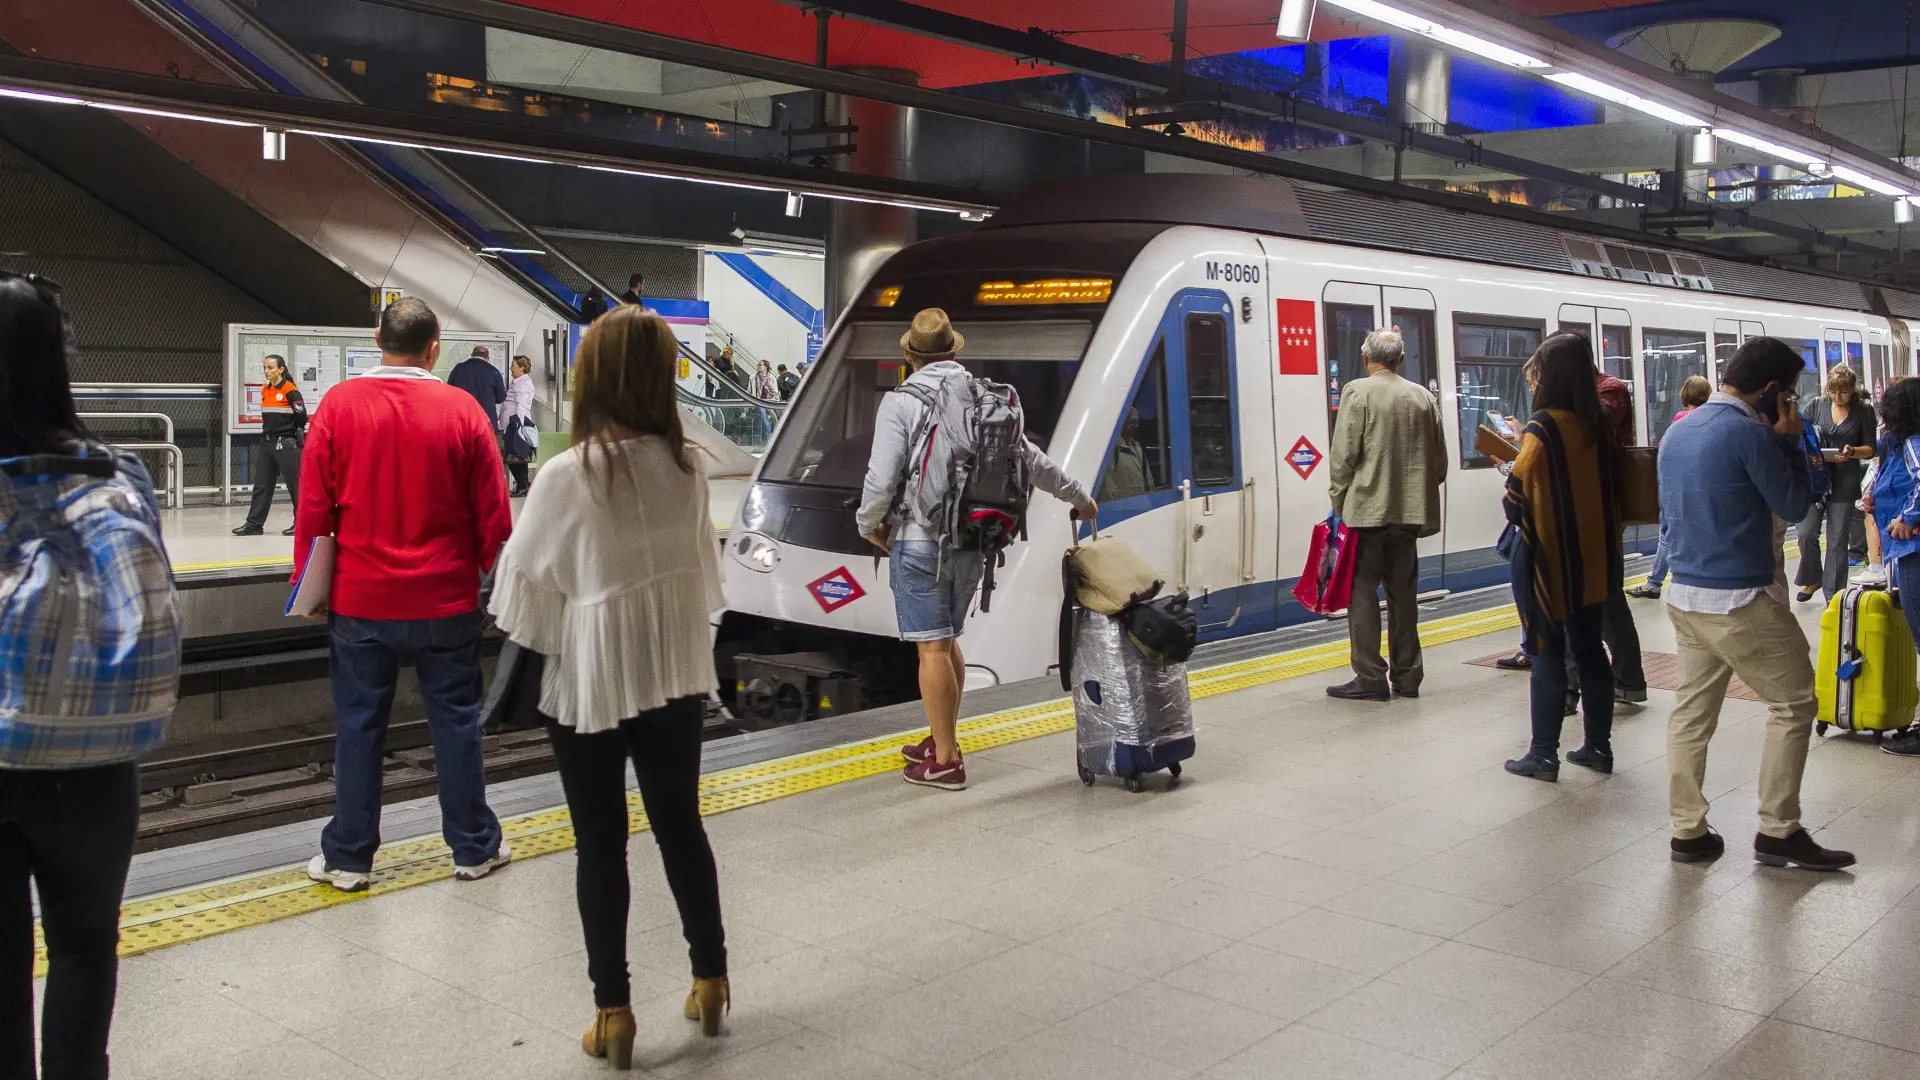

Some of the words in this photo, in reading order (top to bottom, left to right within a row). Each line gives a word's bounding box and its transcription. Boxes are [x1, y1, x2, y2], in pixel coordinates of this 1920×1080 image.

[1206, 261, 1260, 284] M-8060
[244, 336, 266, 345] Plano
[1294, 452, 1314, 463] Metro
[820, 582, 850, 596] Metro
